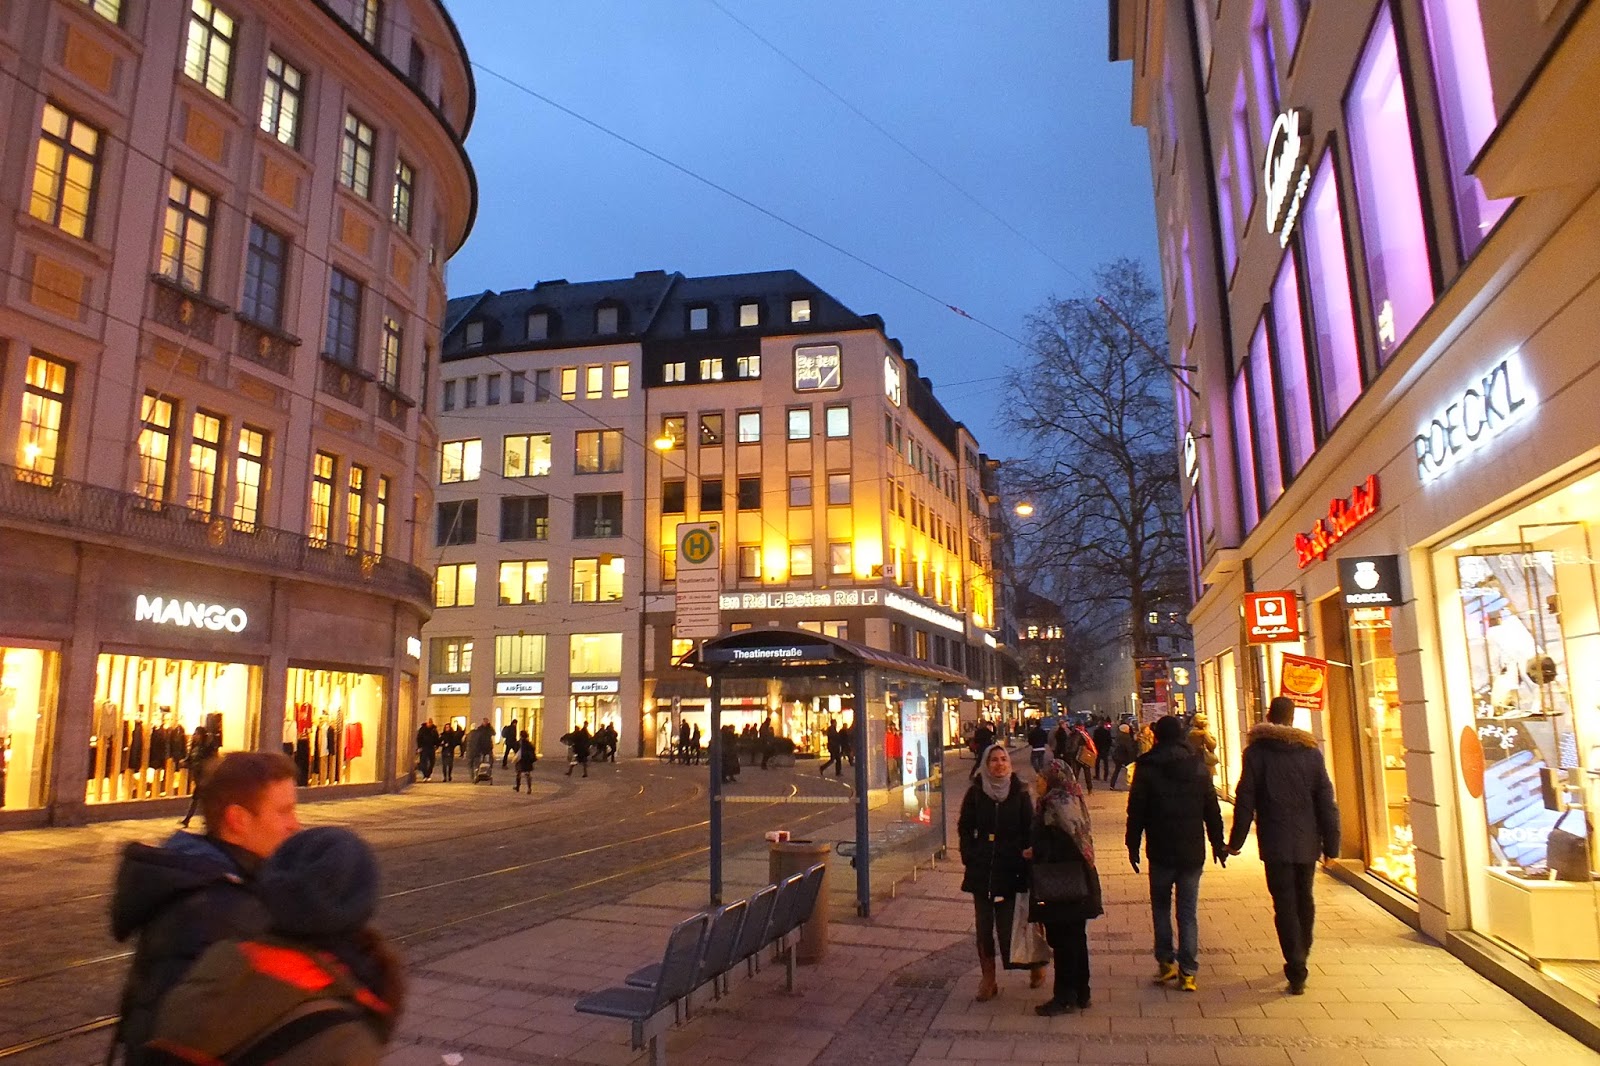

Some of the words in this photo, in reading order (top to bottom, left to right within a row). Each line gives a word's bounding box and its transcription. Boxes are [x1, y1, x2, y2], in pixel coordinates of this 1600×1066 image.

[1413, 358, 1527, 481] ROECKL
[689, 537, 705, 556] H
[886, 566, 894, 575] H
[743, 593, 768, 609] Rid
[785, 591, 831, 608] Betten
[834, 590, 859, 606] Rid
[1346, 593, 1392, 603] ROECKL
[135, 594, 248, 633] MANGO
[733, 648, 803, 659] Theatinerstraße
